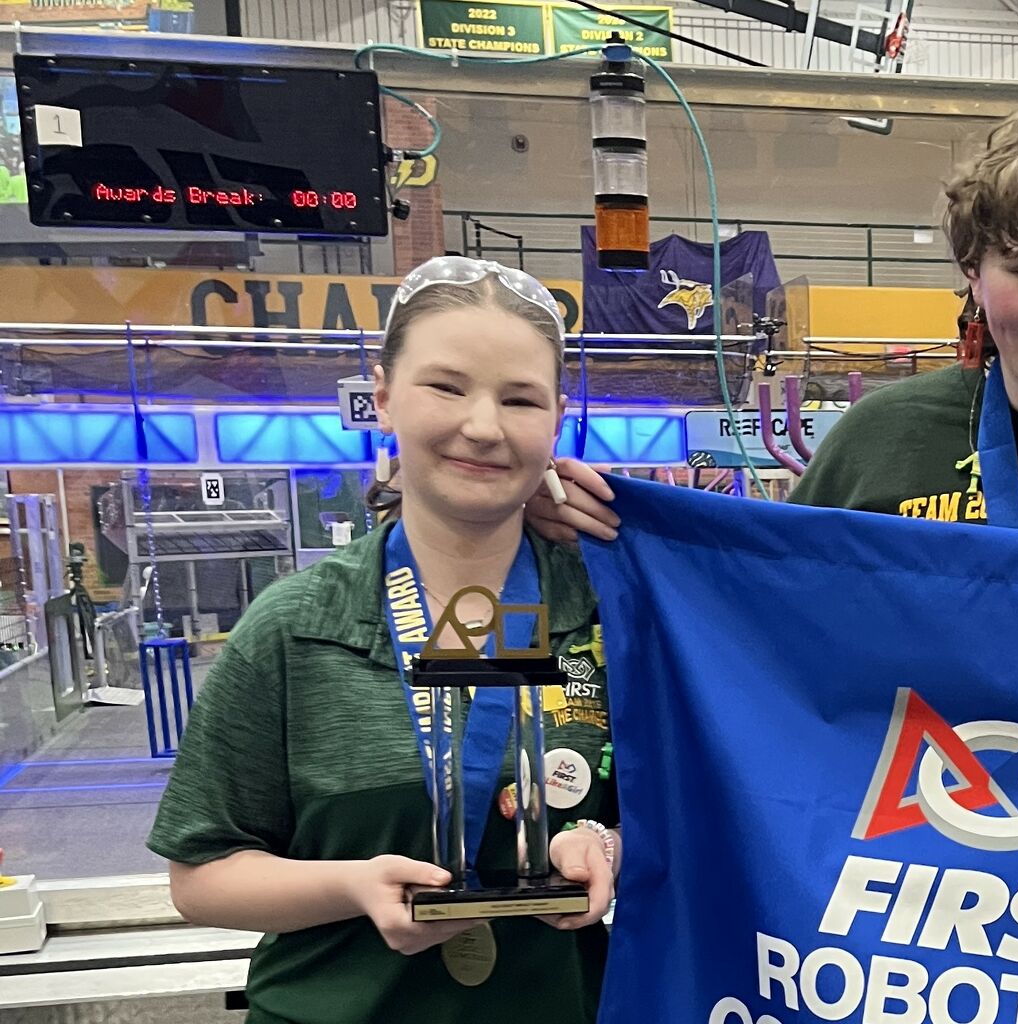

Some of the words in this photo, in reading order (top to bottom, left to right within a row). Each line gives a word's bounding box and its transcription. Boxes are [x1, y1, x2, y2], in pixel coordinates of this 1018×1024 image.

[468, 8, 497, 20] 2022
[451, 23, 505, 36] DIVISION
[507, 26, 516, 36] 3
[428, 37, 468, 50] STATE
[468, 39, 540, 54] CHAMPIONS
[53, 113, 66, 134] 1
[96, 184, 176, 203] Awards
[189, 186, 264, 206] Break:
[292, 190, 357, 209] 00:00
[385, 567, 430, 643] AWARD
